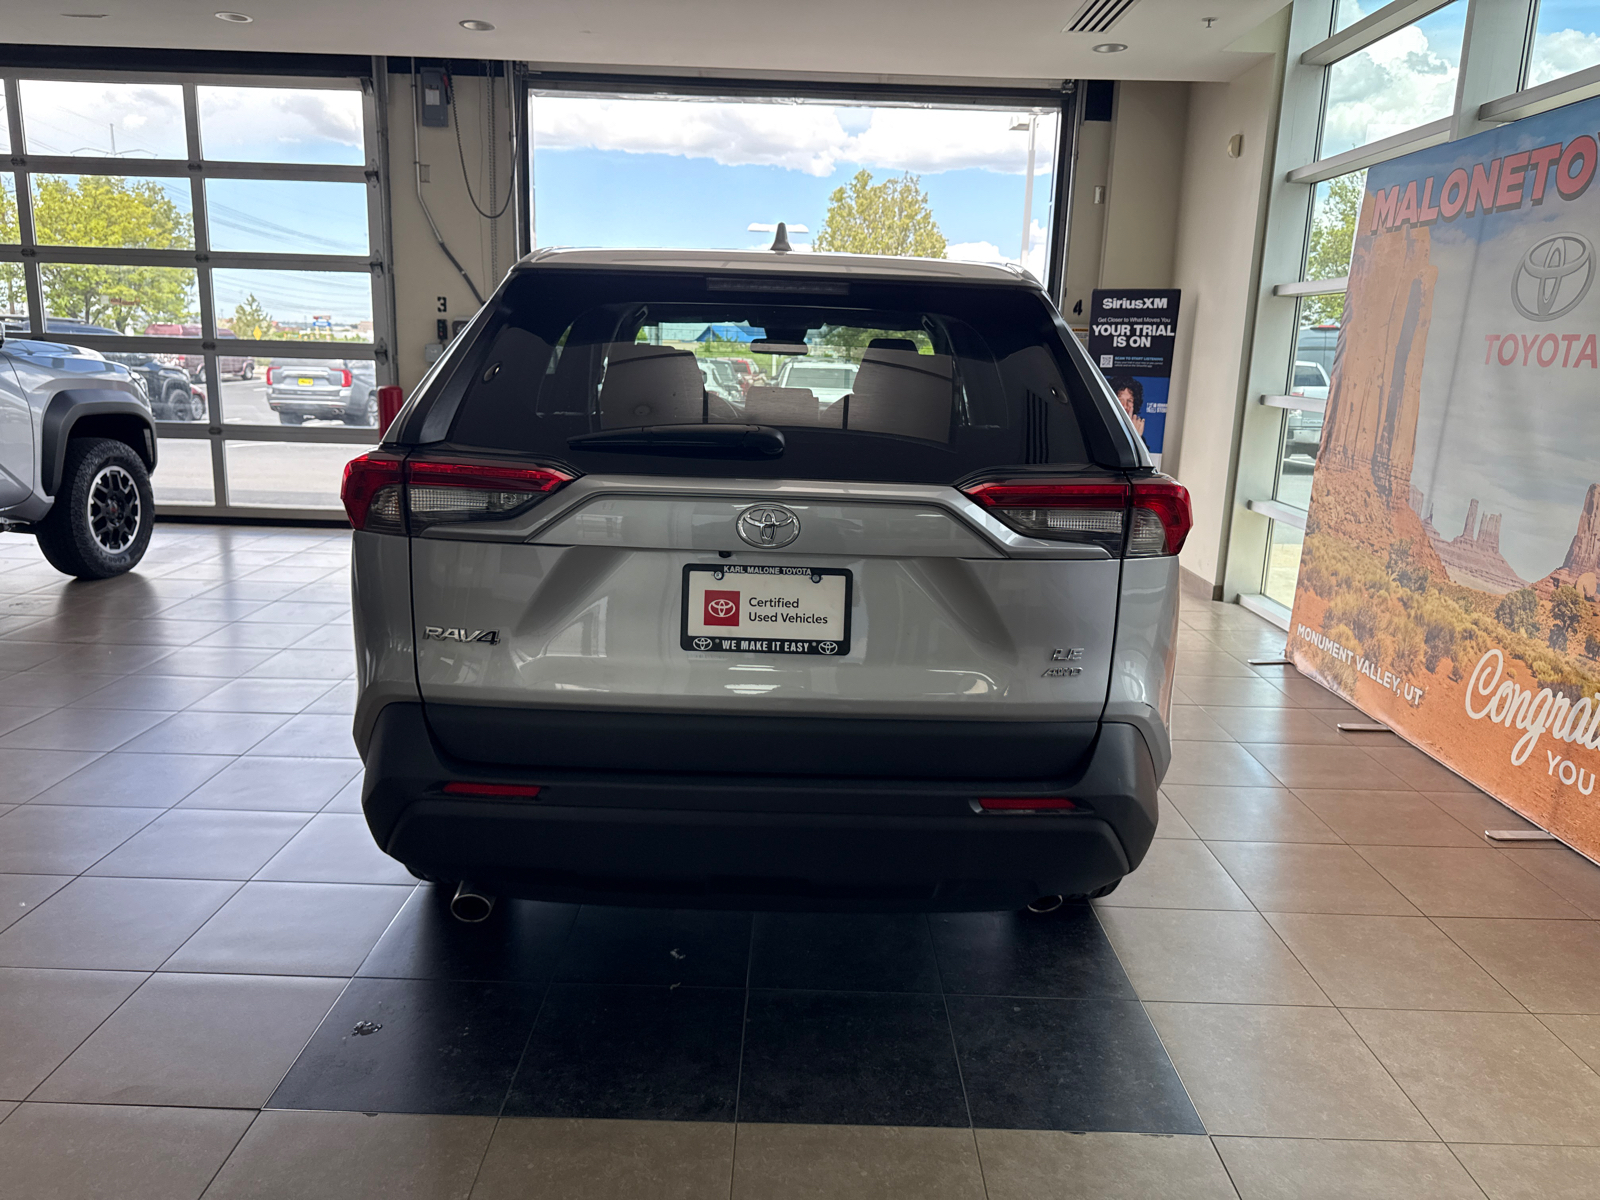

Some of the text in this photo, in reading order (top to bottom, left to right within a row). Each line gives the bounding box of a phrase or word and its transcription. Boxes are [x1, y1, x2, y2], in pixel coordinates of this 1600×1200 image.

[1370, 134, 1600, 236] MALONETO
[437, 296, 447, 312] 3
[1073, 299, 1083, 316] 4
[1102, 297, 1168, 309] SiriusXM
[1092, 324, 1131, 336] YOUR
[1133, 324, 1175, 336] TRIAL
[1113, 336, 1151, 348] IS ON
[1484, 333, 1598, 369] TOYOTA
[723, 565, 811, 576] KARL MALONE TOYOTA
[748, 597, 800, 609] Certified
[748, 612, 828, 625] Used Vehicles
[423, 626, 501, 646] RAV4
[722, 640, 809, 652] WE MAKE IT EASY
[1051, 648, 1085, 661] LE
[1296, 623, 1423, 705] MONUMENT VALLEY, UT
[1041, 667, 1083, 677] AWD
[1465, 649, 1600, 766] Congrat
[1547, 749, 1596, 796] YOU
